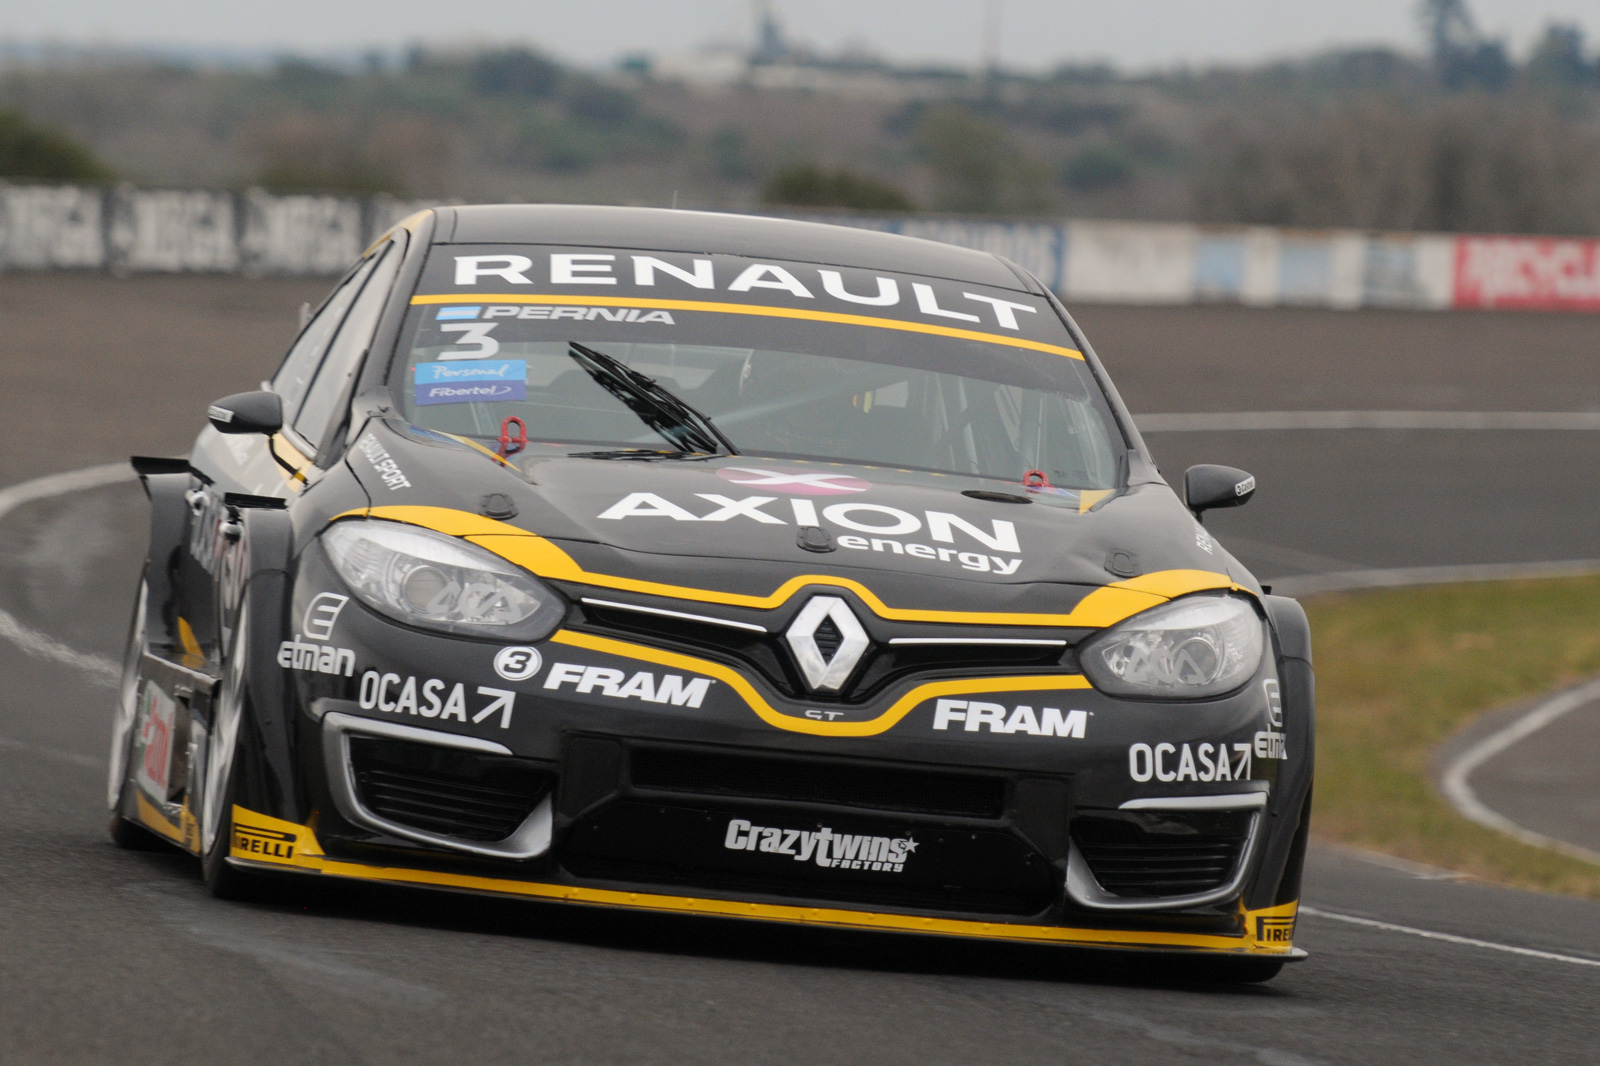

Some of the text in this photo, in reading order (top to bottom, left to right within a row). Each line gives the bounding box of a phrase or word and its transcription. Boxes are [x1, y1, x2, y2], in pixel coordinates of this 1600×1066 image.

[454, 253, 1038, 331] RENAULT
[482, 305, 676, 326] PERNIA
[437, 322, 500, 361] 3
[432, 364, 510, 379] Personal
[428, 385, 498, 398] Fibertel
[373, 459, 412, 491] SPORT
[597, 492, 1021, 553] AXION
[837, 534, 1023, 575] energy
[503, 650, 532, 674] 3
[359, 670, 467, 722] OCASA
[543, 662, 712, 708] FRAM
[805, 709, 844, 721] GT
[933, 698, 1088, 739] FRAM
[1129, 742, 1235, 782] OCASA
[725, 819, 910, 867] Crazytwins
[831, 859, 904, 873] FACTORY
